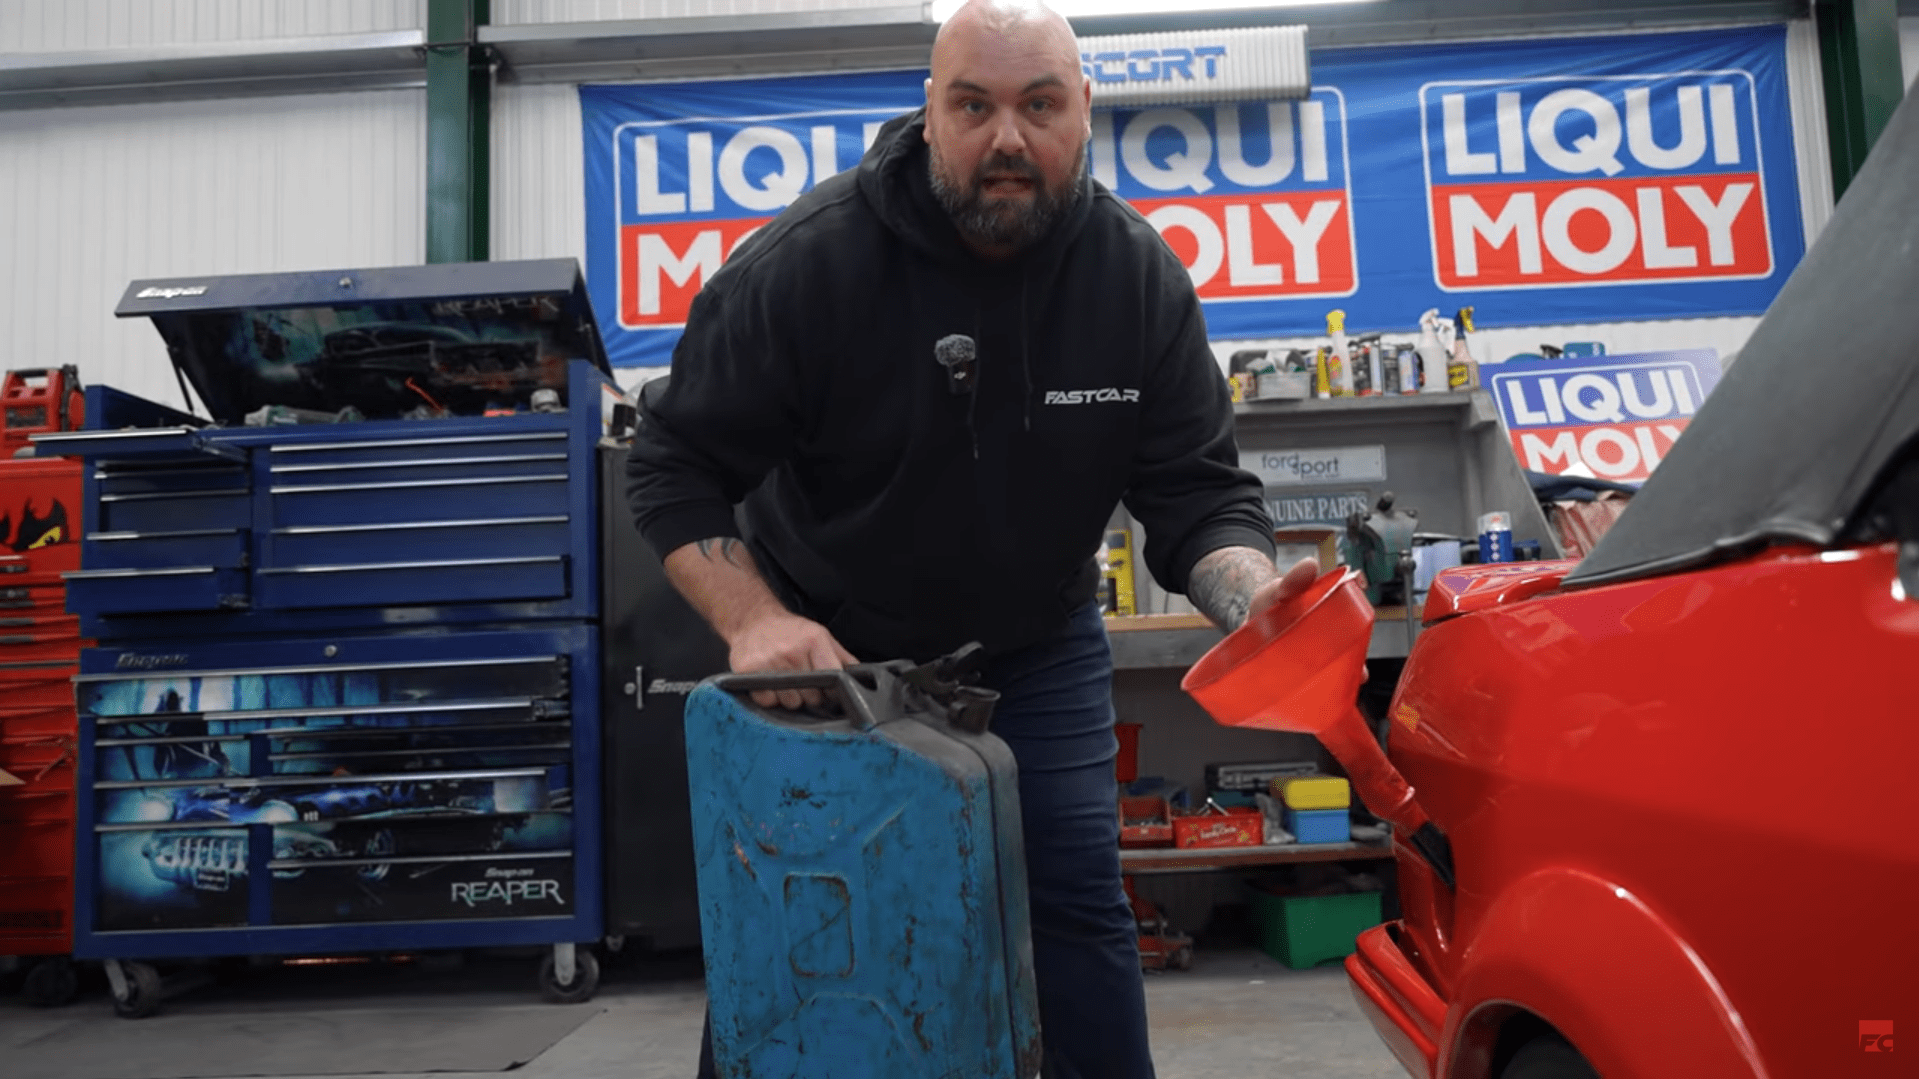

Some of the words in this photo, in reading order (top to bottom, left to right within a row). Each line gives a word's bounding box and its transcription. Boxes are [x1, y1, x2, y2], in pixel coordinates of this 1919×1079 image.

[1081, 45, 1226, 84] CORT
[1090, 101, 1329, 194] IQUI
[1442, 83, 1740, 177] LIQUI
[635, 121, 886, 215] LIQ
[1144, 200, 1342, 289] OLY
[1449, 183, 1755, 277] MOLY
[1044, 387, 1140, 405] FASTCAR
[1505, 369, 1695, 425] LIQUI
[1262, 452, 1299, 469] ford
[1292, 457, 1339, 479] sport
[1263, 498, 1315, 522] NUINE
[1317, 495, 1368, 520] PARTS
[648, 679, 696, 695] Snap
[450, 879, 566, 907] REAPER
